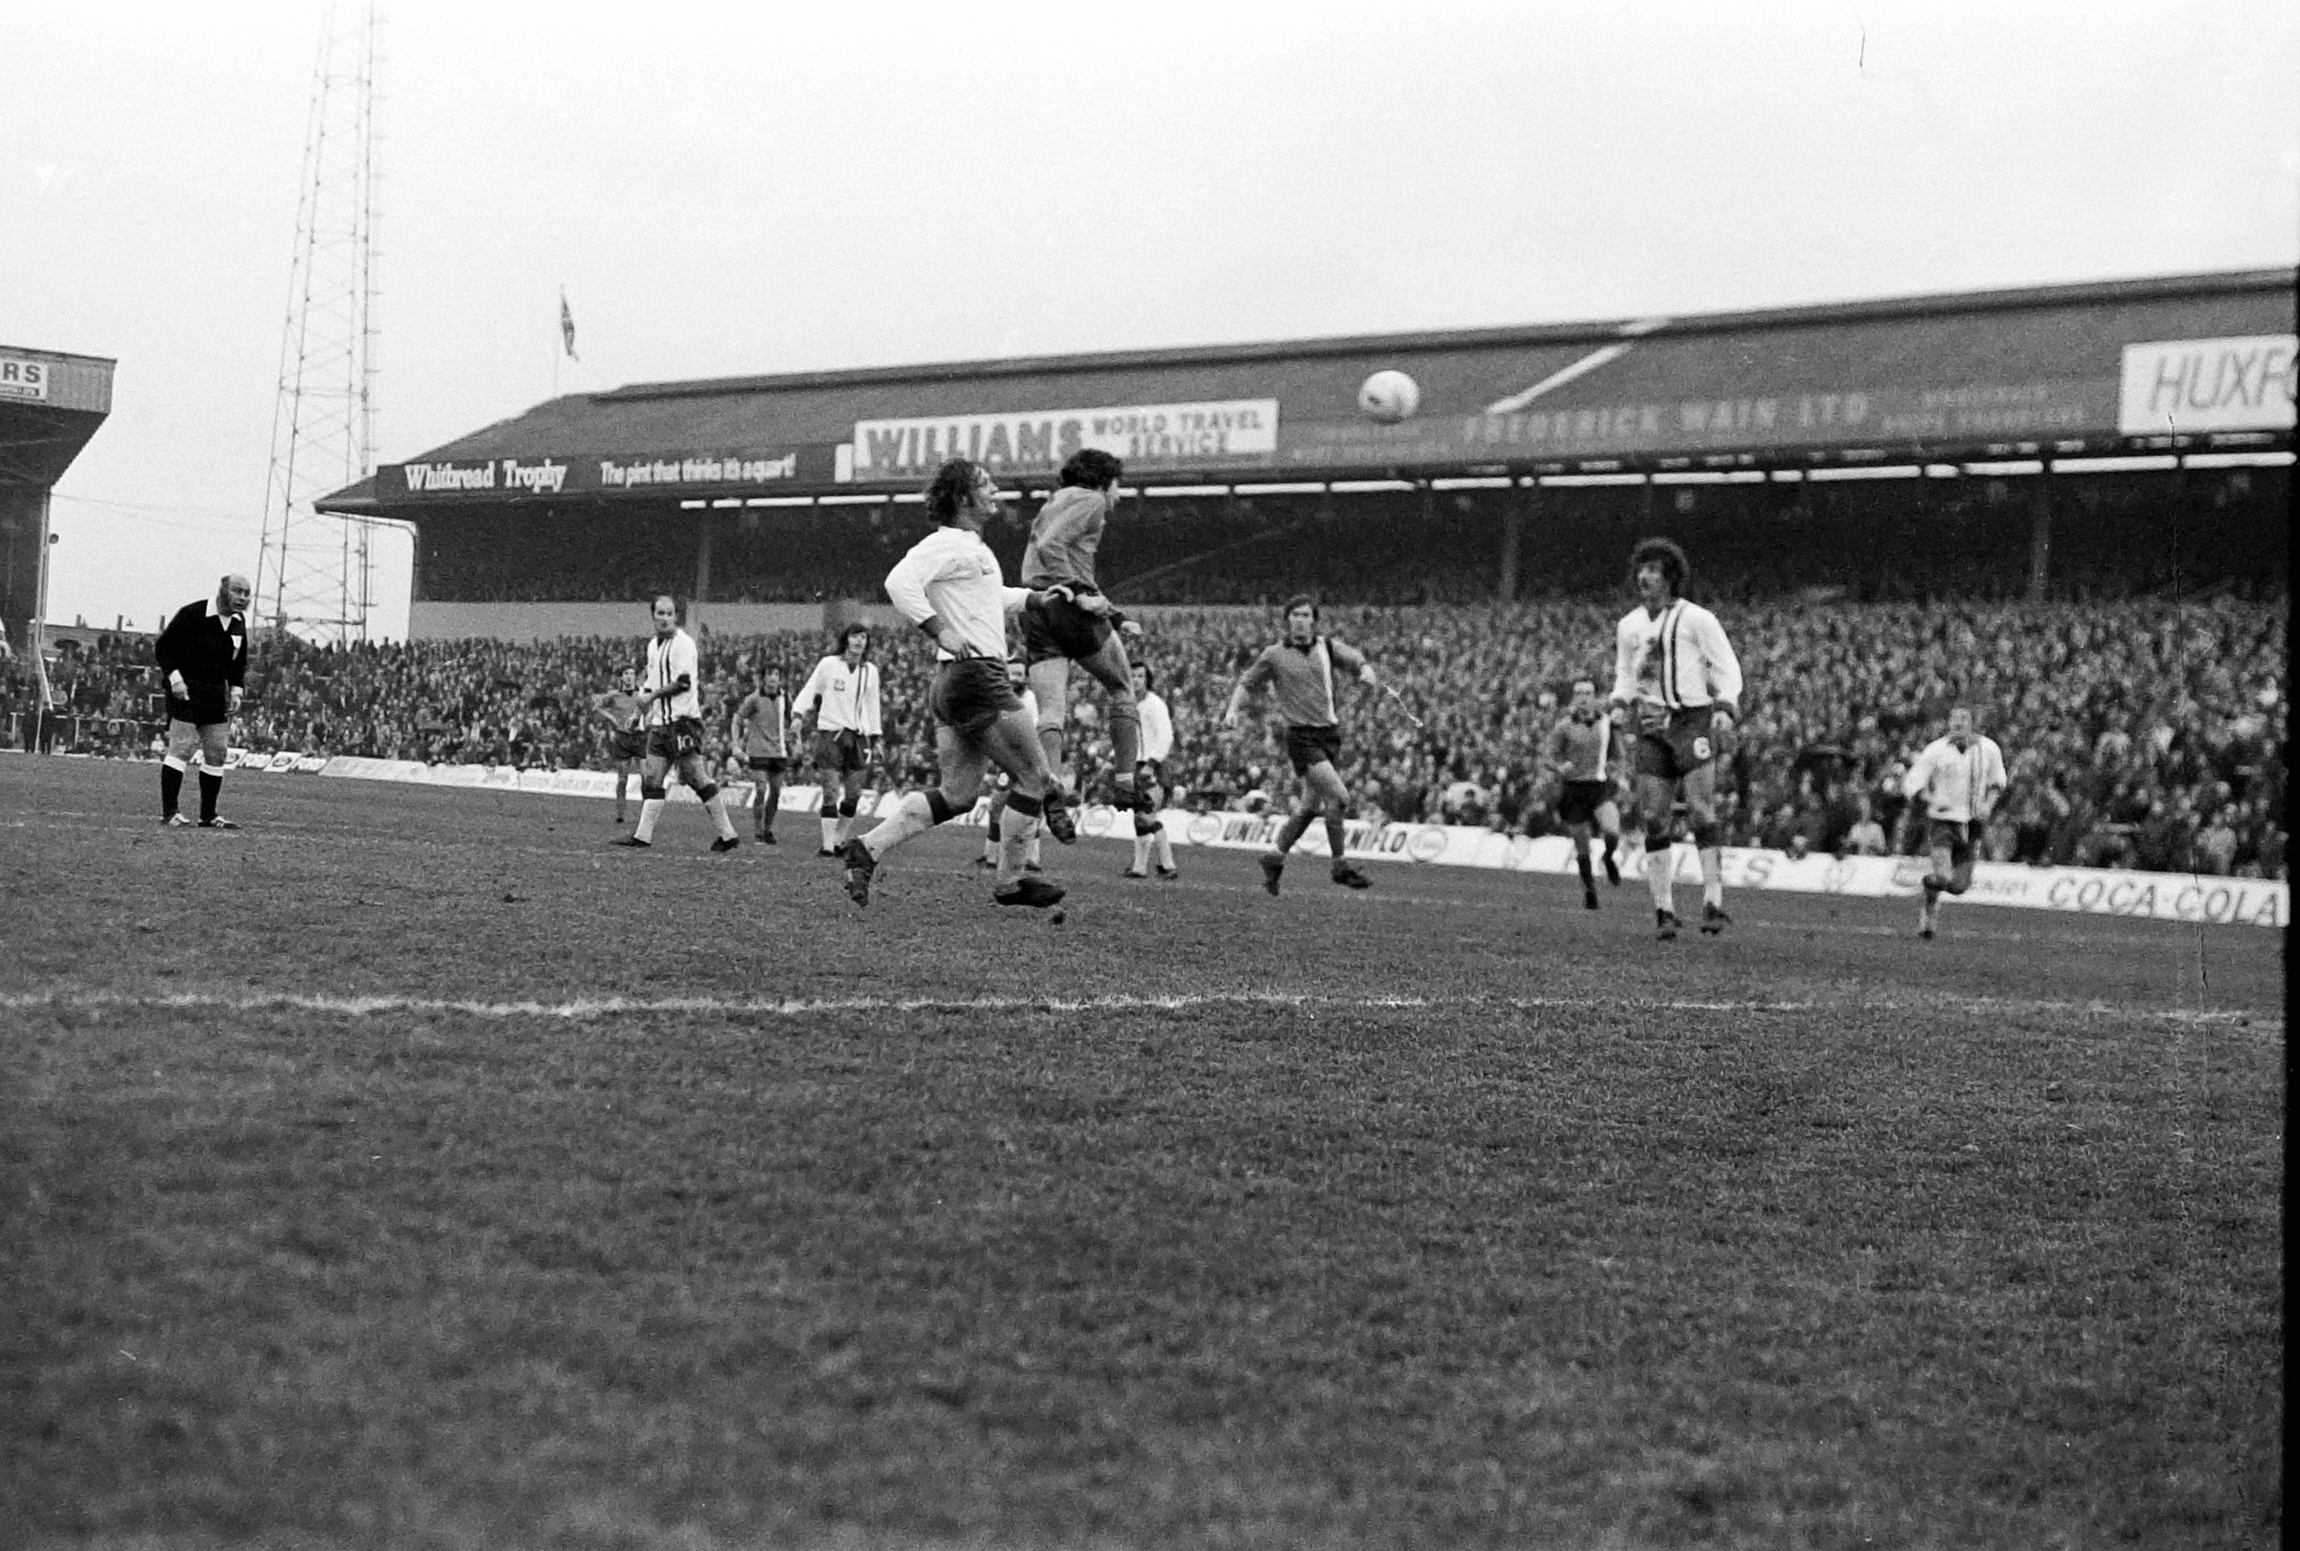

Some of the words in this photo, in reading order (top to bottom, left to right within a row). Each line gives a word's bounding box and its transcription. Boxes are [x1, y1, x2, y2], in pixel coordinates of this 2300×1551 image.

[1093, 413, 1167, 436] WORLD
[1179, 411, 1262, 432] TRAVEL
[866, 419, 1083, 469] WILLIAMS
[405, 460, 496, 491] Whitbread
[503, 458, 568, 493] Trophy
[601, 462, 625, 484] The
[626, 460, 652, 489] pint
[653, 459, 680, 482] that
[676, 734, 695, 751] 10
[1223, 819, 1281, 843] UNIFL
[1342, 828, 1407, 853] NIFLO
[2050, 877, 2156, 917] COCA
[2176, 886, 2277, 928] COLA
